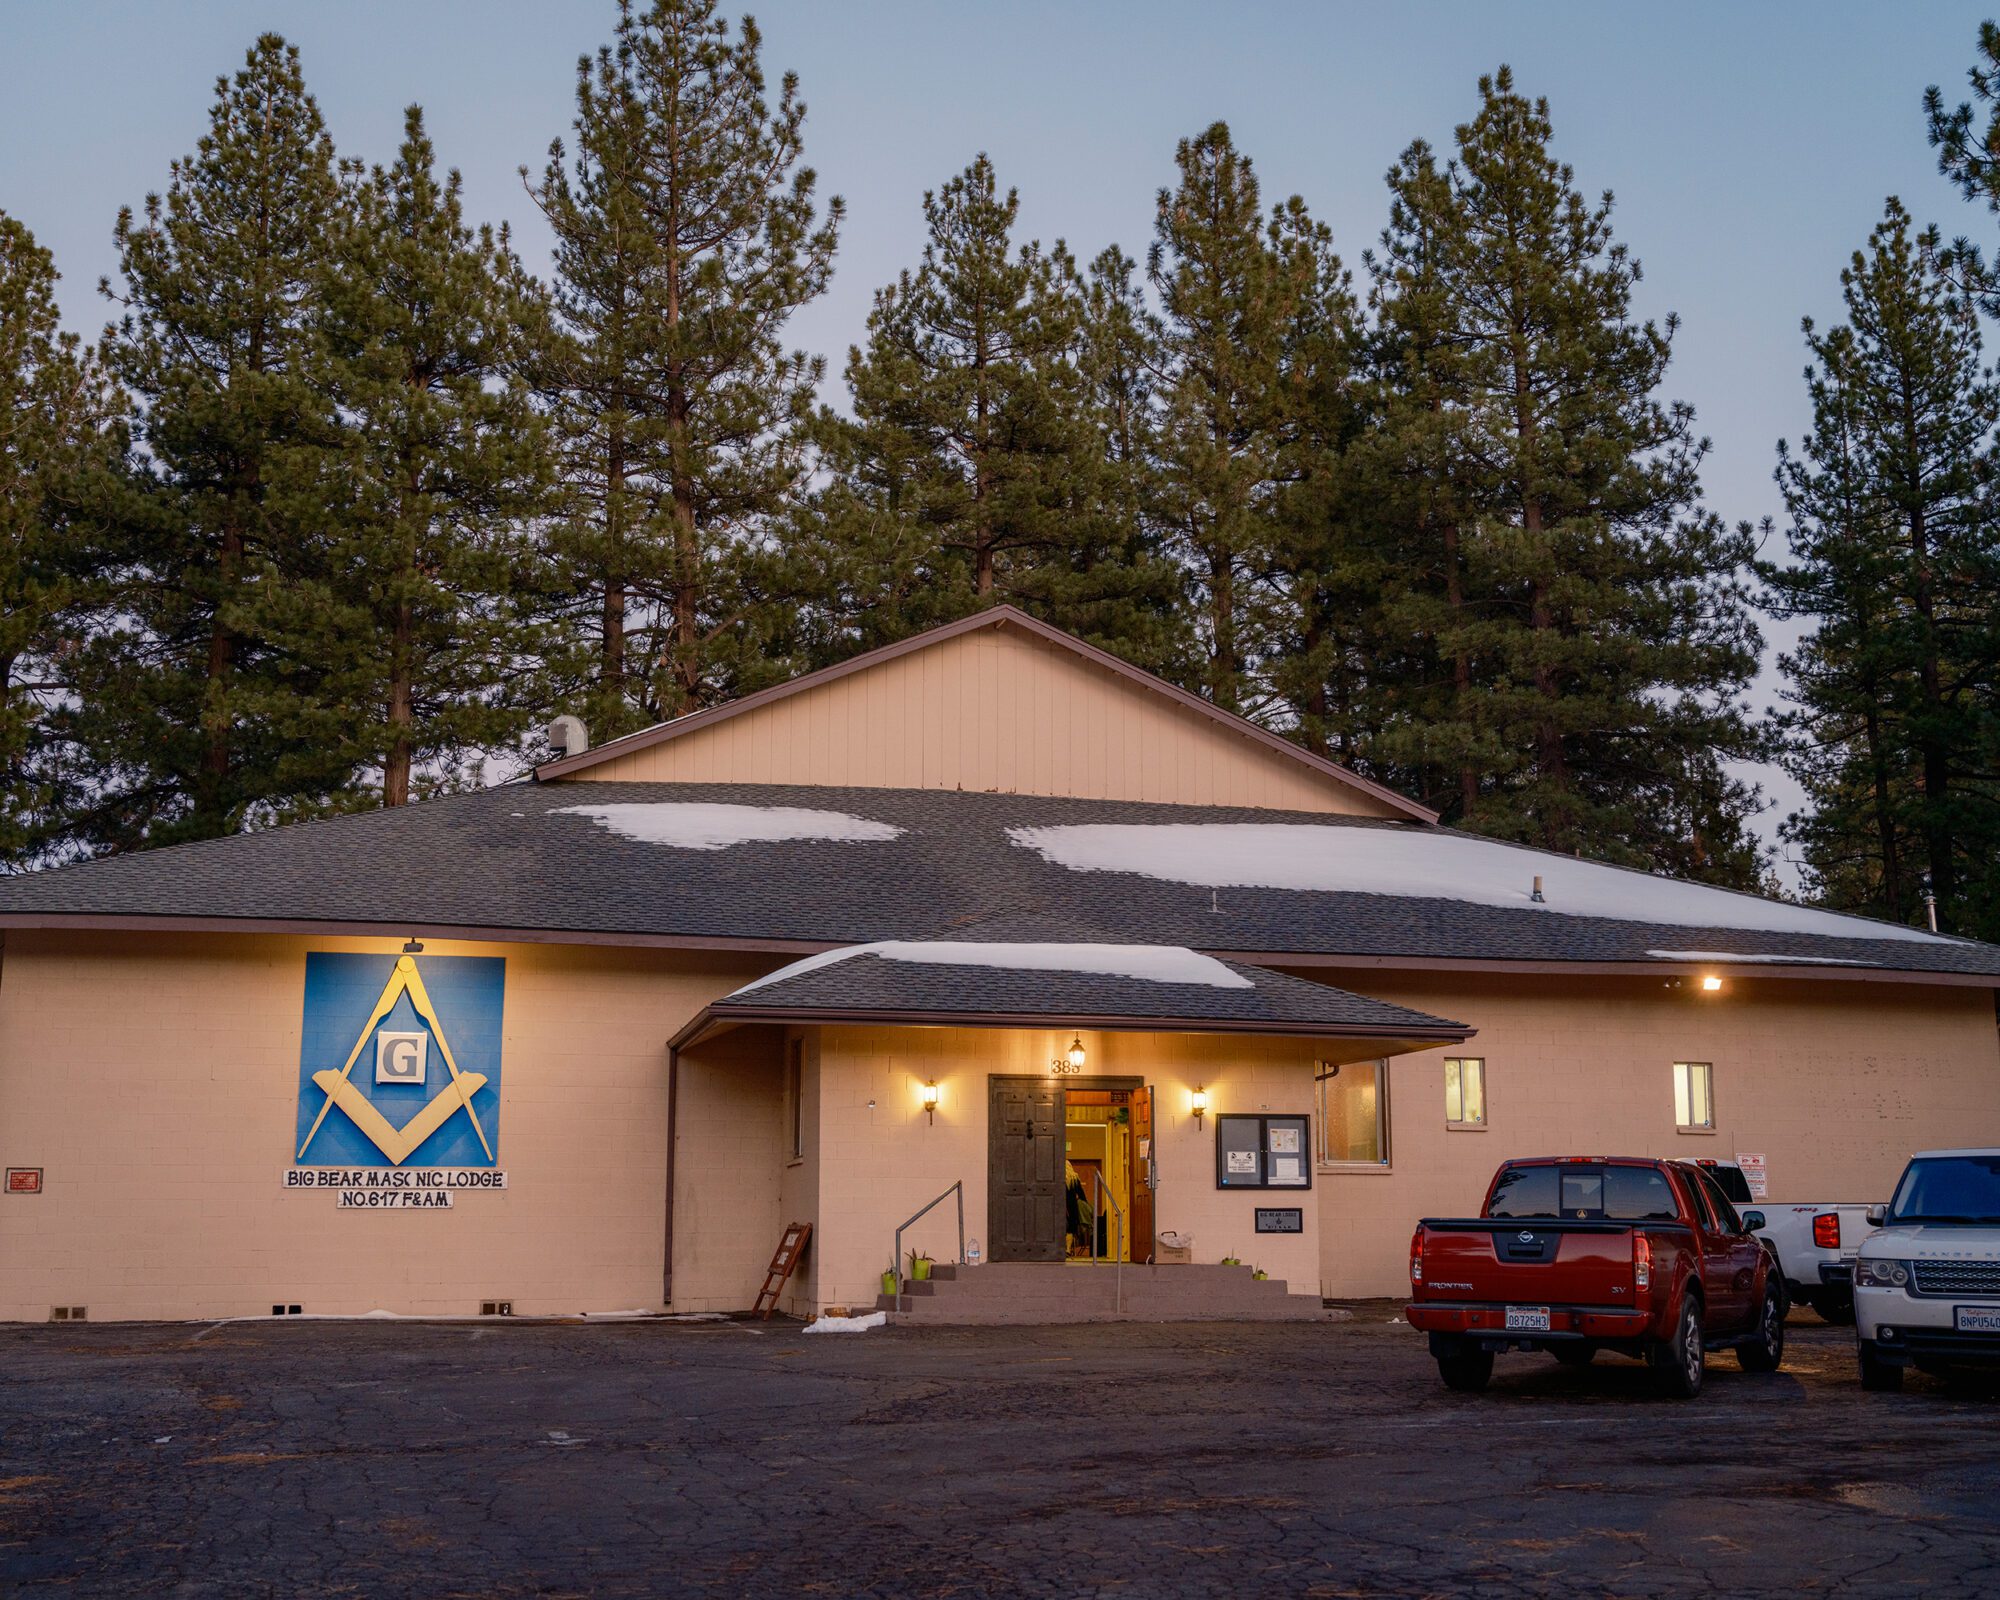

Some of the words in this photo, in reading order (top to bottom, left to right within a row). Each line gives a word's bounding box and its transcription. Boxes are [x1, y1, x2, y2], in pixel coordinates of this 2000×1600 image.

[383, 1039, 418, 1077] G
[288, 1171, 315, 1186] BIG
[317, 1172, 363, 1187] BEAR
[446, 1172, 504, 1188] LODGE
[342, 1191, 399, 1207] NO.617
[402, 1192, 449, 1207] F&AM
[1428, 1282, 1474, 1290] FRONTIER
